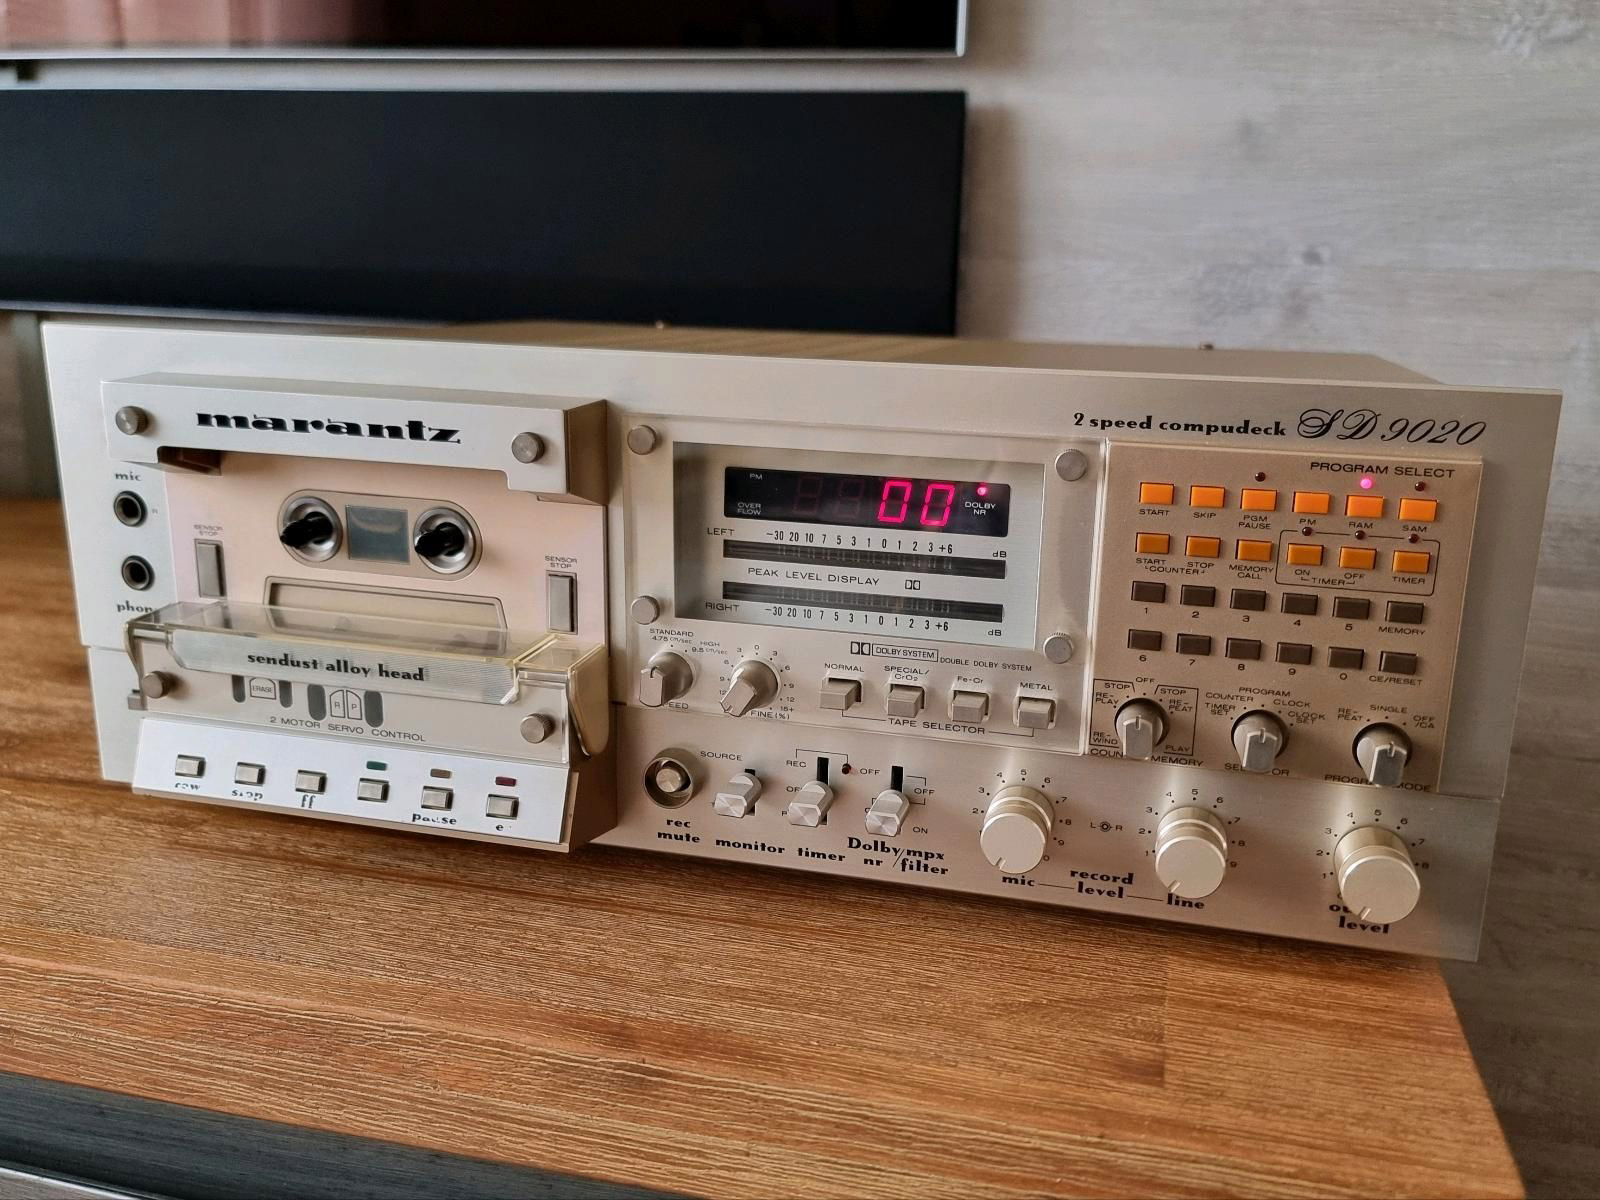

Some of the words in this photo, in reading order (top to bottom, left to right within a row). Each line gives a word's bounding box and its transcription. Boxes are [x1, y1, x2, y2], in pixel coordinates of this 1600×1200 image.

[196, 412, 461, 444] marantz
[1073, 412, 1085, 426] 2
[1090, 415, 1152, 430] speed
[1159, 419, 1286, 436] compudeck
[1310, 462, 1388, 474] PROGRAM
[1394, 467, 1456, 478] SELECT
[115, 471, 142, 482] mic
[965, 501, 996, 509] DOLBY
[1139, 508, 1170, 516] START
[1193, 511, 1216, 519] SKIP
[1243, 514, 1268, 522] PGM
[1299, 518, 1317, 526] PM
[1238, 522, 1272, 530] PAUSE
[1349, 521, 1374, 529] RAM
[706, 528, 735, 536] LEFT
[789, 532, 799, 542] 20
[805, 533, 814, 543] 10
[913, 541, 918, 551] 2
[928, 542, 933, 552] 3
[545, 556, 578, 564] SENSOR
[1135, 557, 1167, 565] START
[1187, 561, 1215, 569] STOP
[1229, 564, 1274, 573] MEMORY
[1148, 566, 1200, 575] COUNTER
[748, 568, 779, 577] PEAK
[786, 571, 822, 581] LEVEL
[828, 574, 880, 586] DISPLAY
[1237, 572, 1262, 580] CALL
[1344, 572, 1365, 580] OFF
[1392, 576, 1426, 584] TIMER
[1312, 577, 1346, 586] TIMER
[117, 600, 153, 613] phon
[705, 602, 740, 612] RIGHT
[1144, 607, 1148, 615] 1
[787, 607, 797, 618] 20
[803, 609, 812, 619] 10
[820, 610, 824, 620] 7
[849, 613, 854, 623] 3
[909, 618, 914, 628] 2
[925, 620, 930, 629] 3
[1192, 611, 1200, 619] 2
[1345, 623, 1353, 631] 5
[1378, 626, 1426, 636] MEMORY
[649, 628, 694, 638] STANDARD
[876, 647, 901, 657] DOLBY
[902, 649, 935, 659] SYSTEM
[940, 657, 969, 666] DOUBLE
[973, 660, 998, 669] DOLBY
[1002, 663, 1032, 672] SYSTEM
[1139, 654, 1147, 662] 6
[1188, 658, 1196, 667] 7
[247, 653, 318, 670] sendust
[325, 660, 371, 677] alloy
[378, 664, 425, 682] head
[824, 662, 865, 673] NORMAL
[957, 676, 984, 684] Fe-Cr
[1368, 675, 1423, 686] CE/RESET
[252, 684, 274, 694] ERASE
[1019, 682, 1053, 691] METAL
[1104, 682, 1130, 690] STOP
[1160, 688, 1187, 696] STOP
[1205, 691, 1254, 702] COUNTER
[1239, 687, 1291, 697] PROGRAM
[334, 702, 341, 710] R
[351, 703, 358, 711] P
[1205, 702, 1236, 711] TIMER
[1273, 699, 1311, 708] CLOCK
[1370, 704, 1408, 714] SINGLE
[1287, 711, 1325, 720] CLOCK
[1337, 713, 1364, 721] PEAT
[1413, 715, 1435, 723] OFF
[269, 716, 277, 724] 2
[281, 718, 321, 729] MOTOR
[328, 723, 364, 735] SERVO
[371, 729, 426, 742] CONTROL
[888, 718, 917, 728] TAPE
[922, 721, 986, 735] SELECTOR
[1093, 737, 1118, 745] WIND
[700, 750, 743, 761] SOURCE
[1090, 748, 1124, 758] COUN
[1151, 756, 1204, 767] MEMORY
[786, 760, 807, 768] REC
[859, 768, 881, 776] OFF
[914, 787, 935, 796] OFF
[1393, 783, 1432, 793] ODE
[666, 818, 691, 829] rec
[913, 826, 929, 834] ON
[657, 830, 701, 844] mute
[715, 837, 785, 854] monitor
[798, 847, 846, 862] timer
[863, 858, 883, 867] nr
[1001, 876, 1035, 887] mic
[1070, 869, 1134, 885] record
[1077, 881, 1124, 899] level
[1167, 892, 1205, 910] line
[1339, 916, 1389, 934] level
